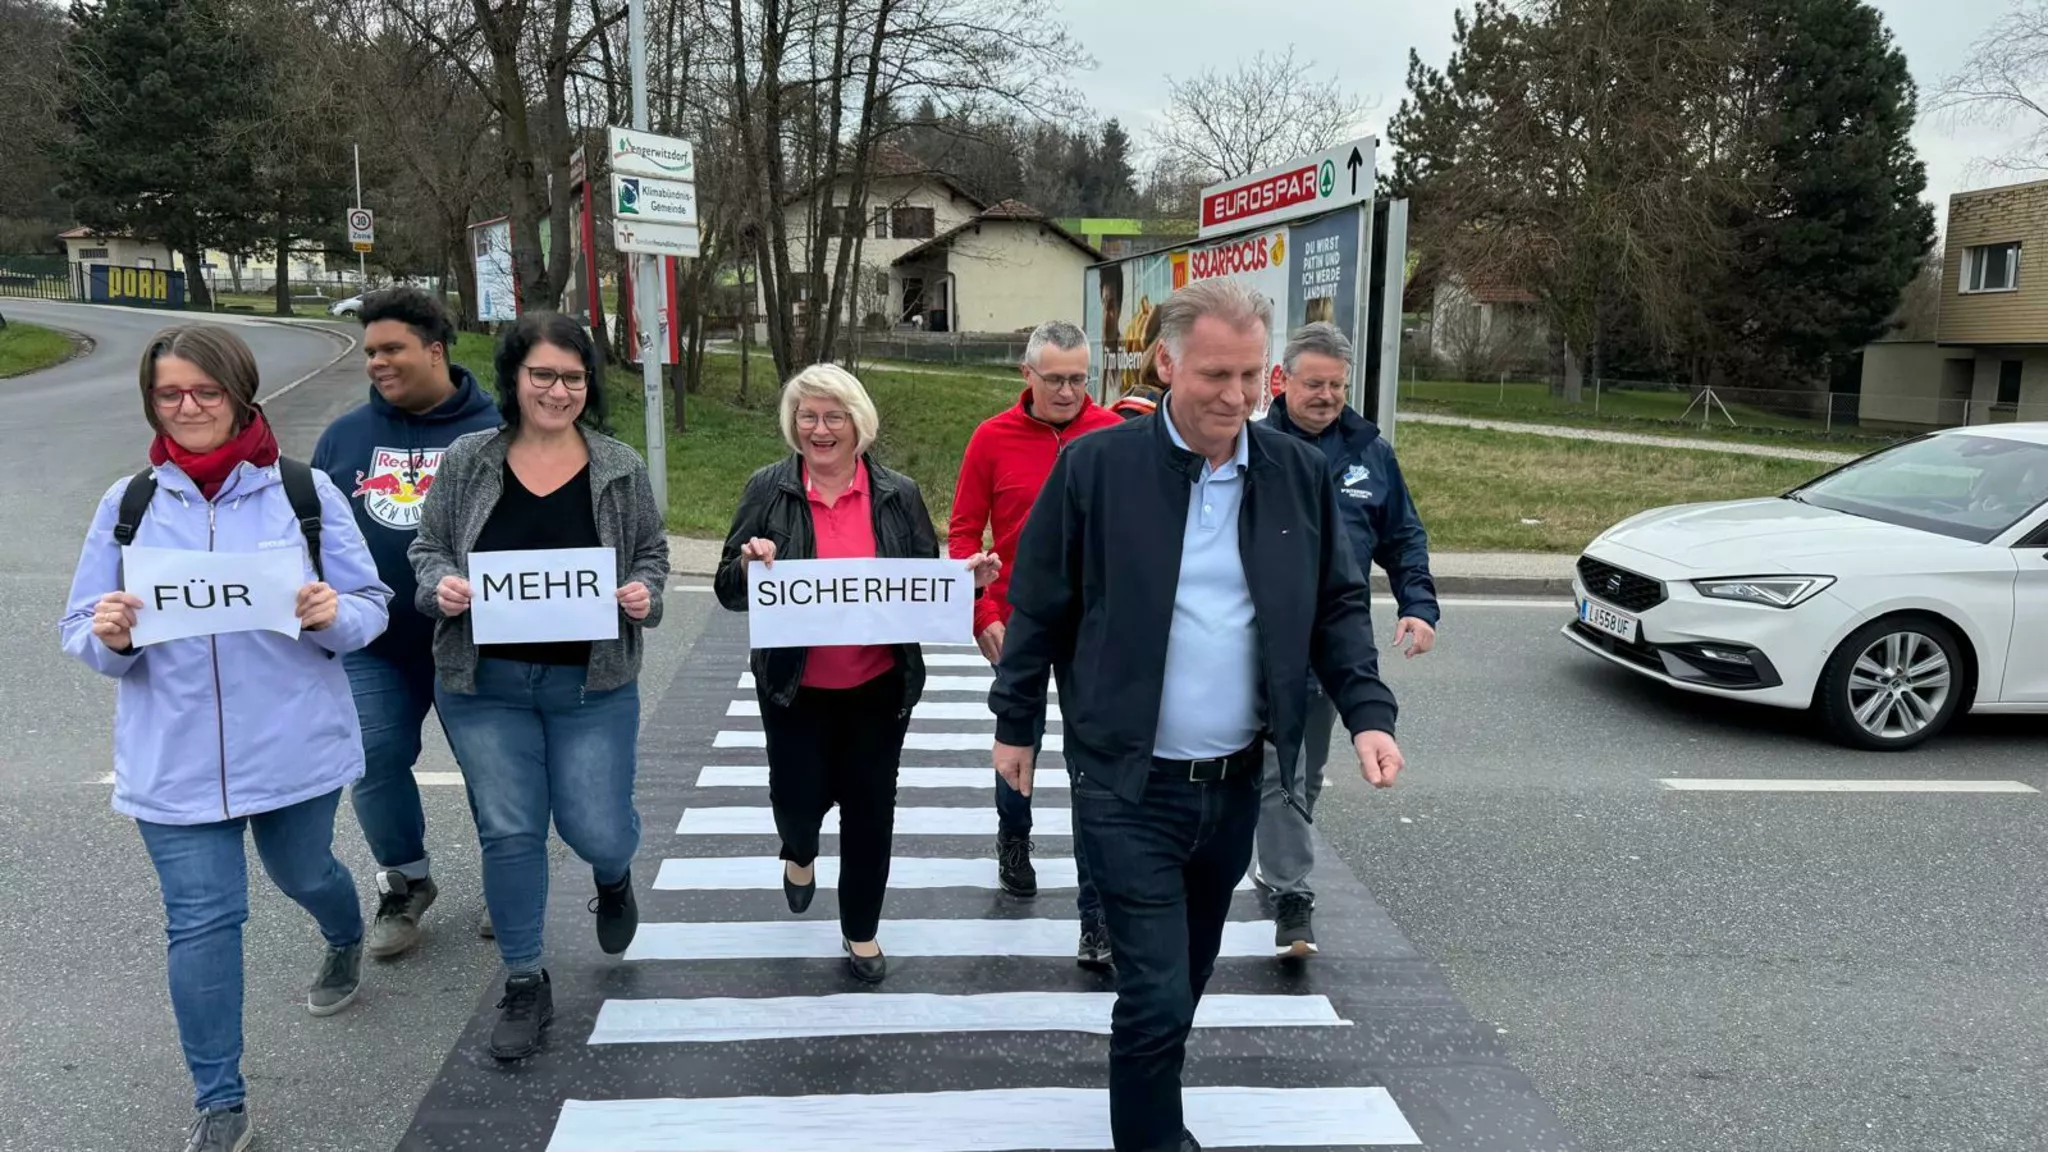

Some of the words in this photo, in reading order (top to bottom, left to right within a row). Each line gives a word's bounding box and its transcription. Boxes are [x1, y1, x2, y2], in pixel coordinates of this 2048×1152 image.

[642, 185, 693, 200] Klimabündnis-
[1213, 170, 1316, 220] EUROSPAR
[651, 201, 687, 215] Gemeinde
[355, 215, 367, 226] 30
[352, 231, 371, 240] Zone
[1305, 240, 1315, 256] DU
[1316, 235, 1340, 253] WIRST
[1191, 236, 1268, 280] SOLARFOCUS
[1303, 254, 1324, 272] PATIN
[1325, 251, 1341, 268] UND
[108, 266, 167, 300] PORR
[1301, 270, 1315, 286] ICH
[1316, 266, 1341, 284] WERDE
[1303, 282, 1339, 301] LANDWIRT
[1118, 346, 1142, 370] übern
[373, 497, 399, 521] NEW
[153, 578, 252, 611] FÜR
[482, 569, 599, 601] MEHR
[757, 577, 956, 606] SICHERHEIT
